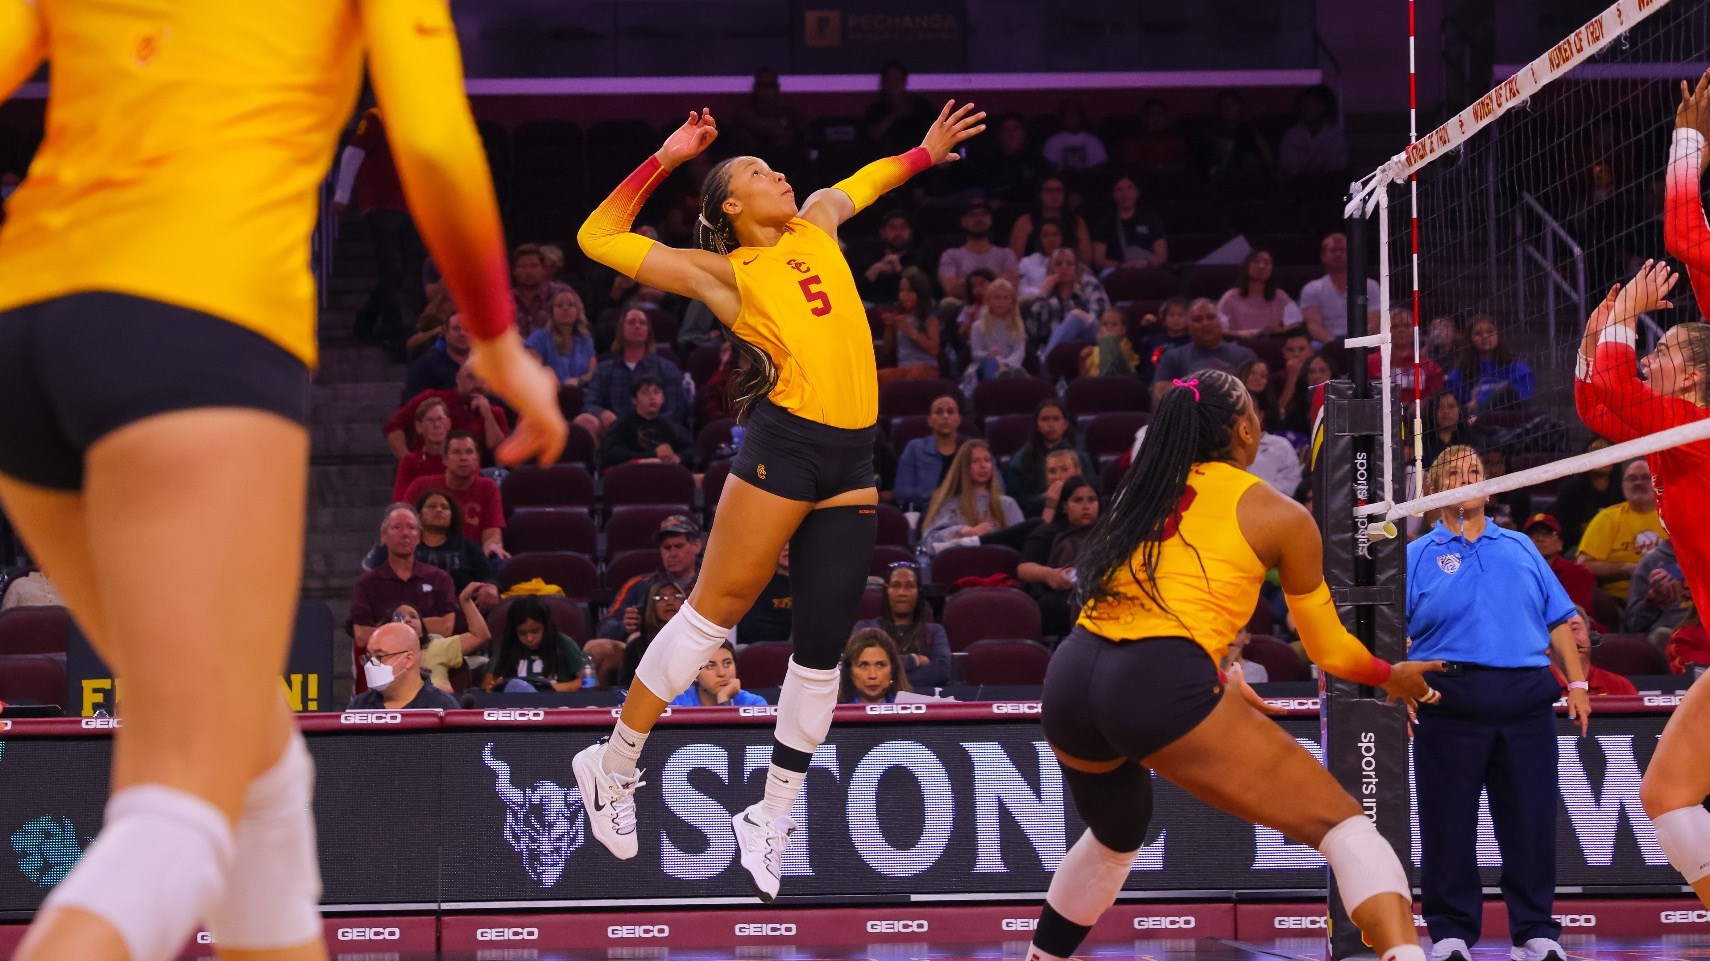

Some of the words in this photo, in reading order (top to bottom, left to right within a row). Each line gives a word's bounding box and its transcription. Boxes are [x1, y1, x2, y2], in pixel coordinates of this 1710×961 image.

[797, 274, 832, 317] 5
[280, 673, 318, 711] N!
[1643, 696, 1685, 706] GEI
[739, 706, 778, 717] GEI
[866, 703, 927, 715] GEICO
[992, 703, 1043, 714] GEIC
[340, 713, 402, 724] GEICO
[483, 710, 545, 721] GEICO
[81, 718, 122, 729] GEIC
[1357, 732, 1379, 794] sports
[660, 740, 1166, 880] STON
[1133, 916, 1196, 929] GEICO
[1550, 914, 1596, 927] ICO
[1660, 910, 1710, 923] GEIC
[734, 923, 797, 936] GEICO
[866, 920, 929, 933] GEICO
[1001, 918, 1040, 931] GEI
[337, 927, 400, 940] GEICO
[476, 927, 539, 941] GEICO
[607, 925, 670, 938] GEICO
